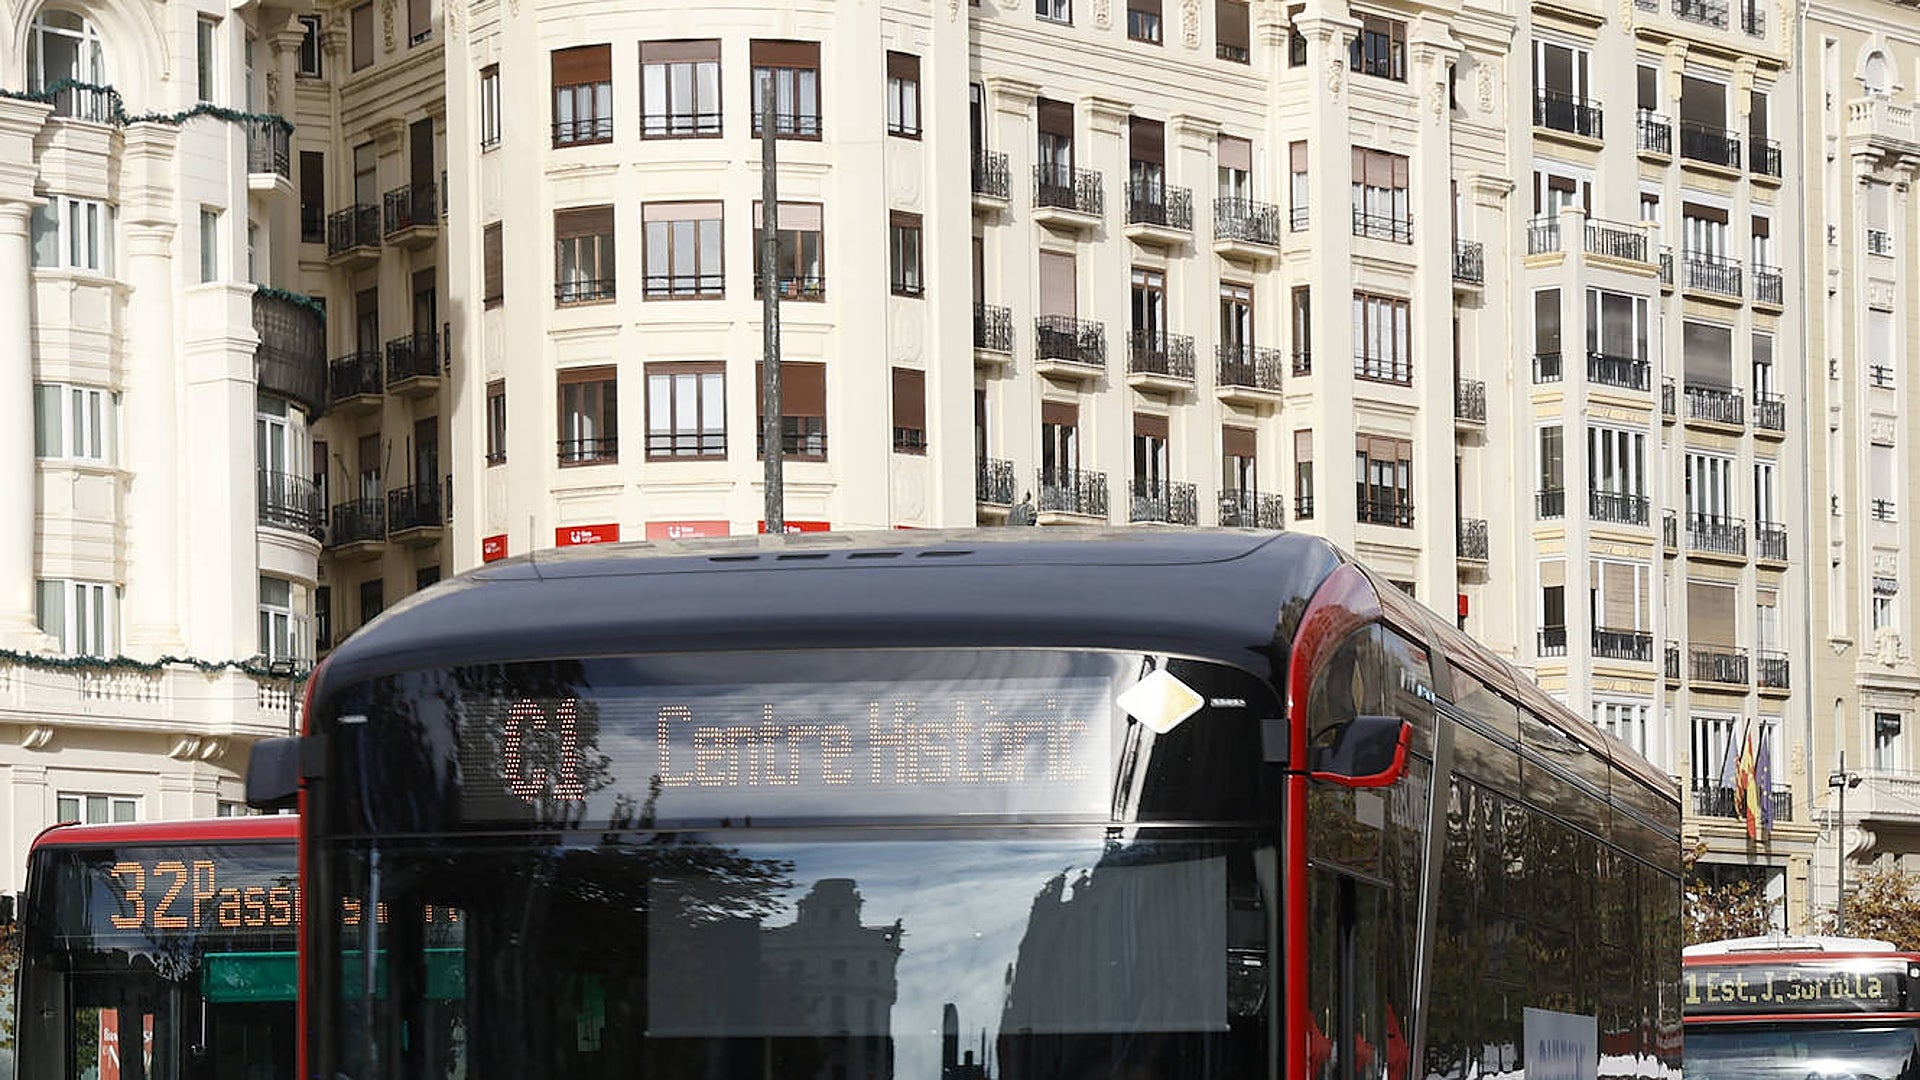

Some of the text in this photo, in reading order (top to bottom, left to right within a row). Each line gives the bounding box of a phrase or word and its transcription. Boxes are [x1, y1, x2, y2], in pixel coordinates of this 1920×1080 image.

[504, 698, 1091, 800] C1 Centre Històric
[110, 861, 188, 929] 32
